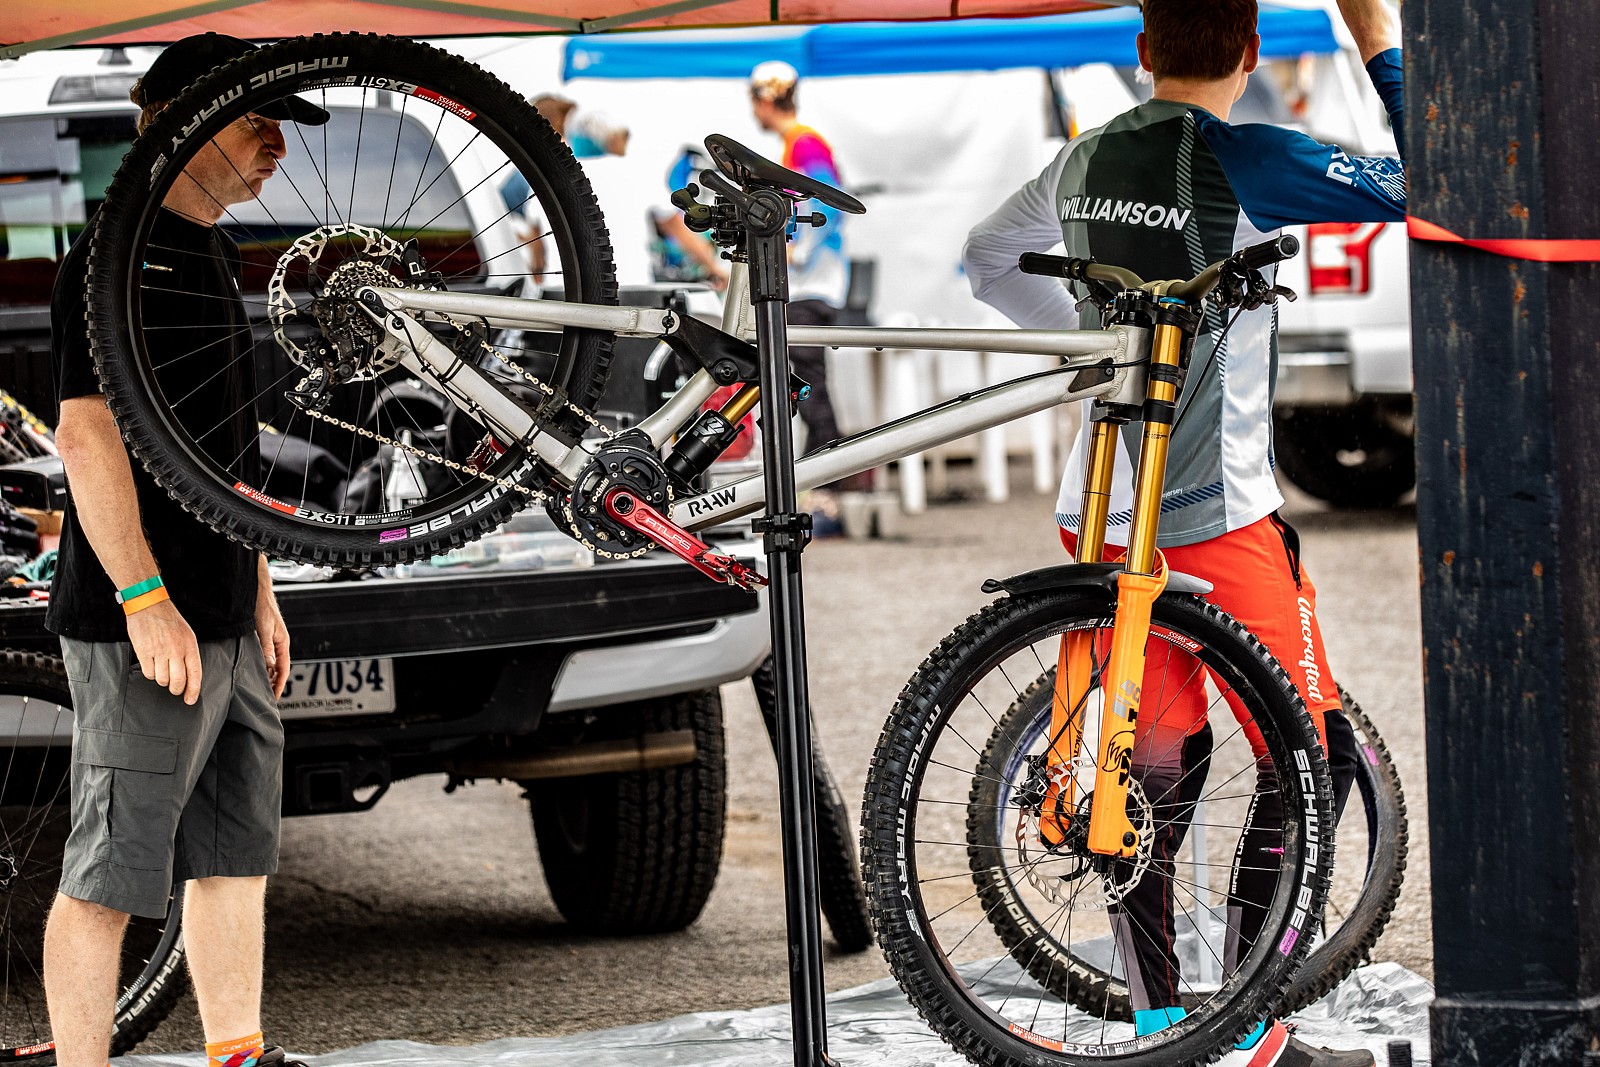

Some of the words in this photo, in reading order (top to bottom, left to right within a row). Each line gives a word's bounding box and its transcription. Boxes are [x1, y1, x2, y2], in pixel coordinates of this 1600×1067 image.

[250, 56, 349, 91] MAGIC
[359, 75, 418, 95] EX511
[172, 84, 244, 154] MARY
[437, 95, 459, 110] SWISS
[1061, 196, 1192, 232] WILLIAMSON
[251, 492, 273, 506] SWISS
[294, 507, 351, 526] EX511
[645, 517, 692, 551] ATLAS
[1167, 631, 1187, 644] SWISS
[1297, 596, 1324, 703] Uncrafted
[900, 703, 942, 801] MAGIC
[895, 807, 913, 902] MARY
[1236, 836, 1246, 856] UP
[1289, 748, 1319, 931] SCHWALBE
[990, 866, 1038, 938] MAGIC
[1035, 937, 1105, 985] MARY
[31, 1043, 51, 1053] SWISS
[1062, 1043, 1110, 1056] EX511
